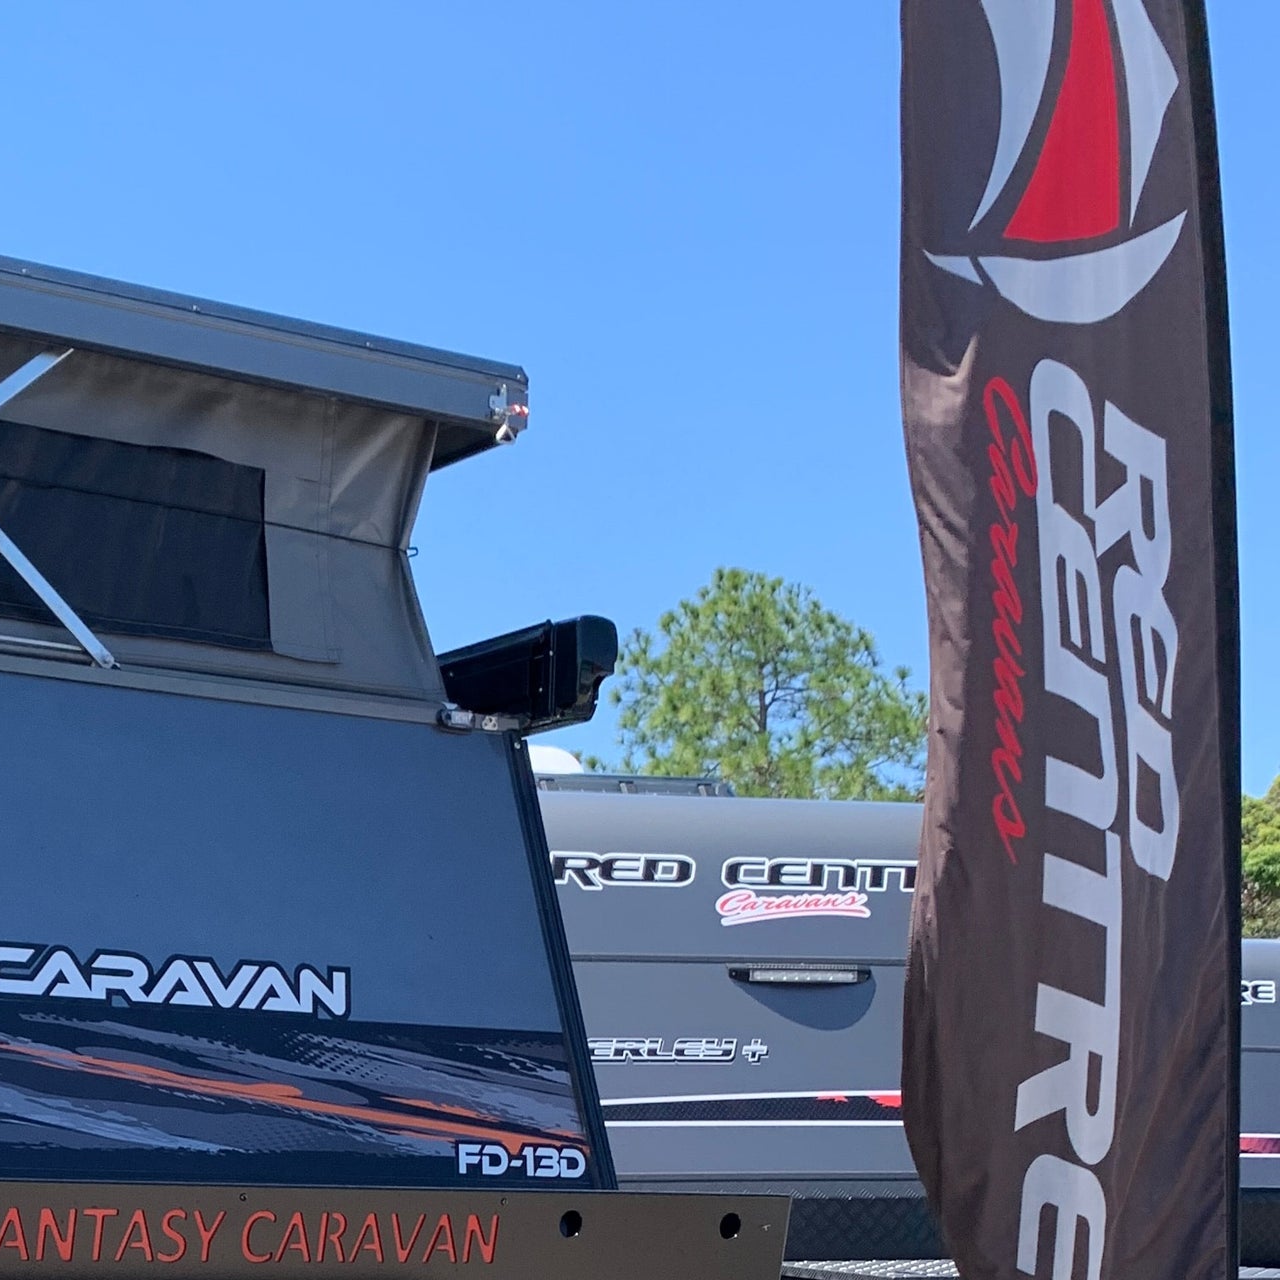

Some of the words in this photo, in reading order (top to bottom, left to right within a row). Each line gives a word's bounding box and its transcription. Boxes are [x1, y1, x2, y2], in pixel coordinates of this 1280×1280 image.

[983, 376, 1039, 866] Caravans
[1096, 400, 1180, 881] RED
[550, 851, 696, 890] RED
[719, 893, 861, 916] Caravans
[458, 1143, 586, 1178] FD-13D
[241, 1211, 500, 1265] CARAVAN
